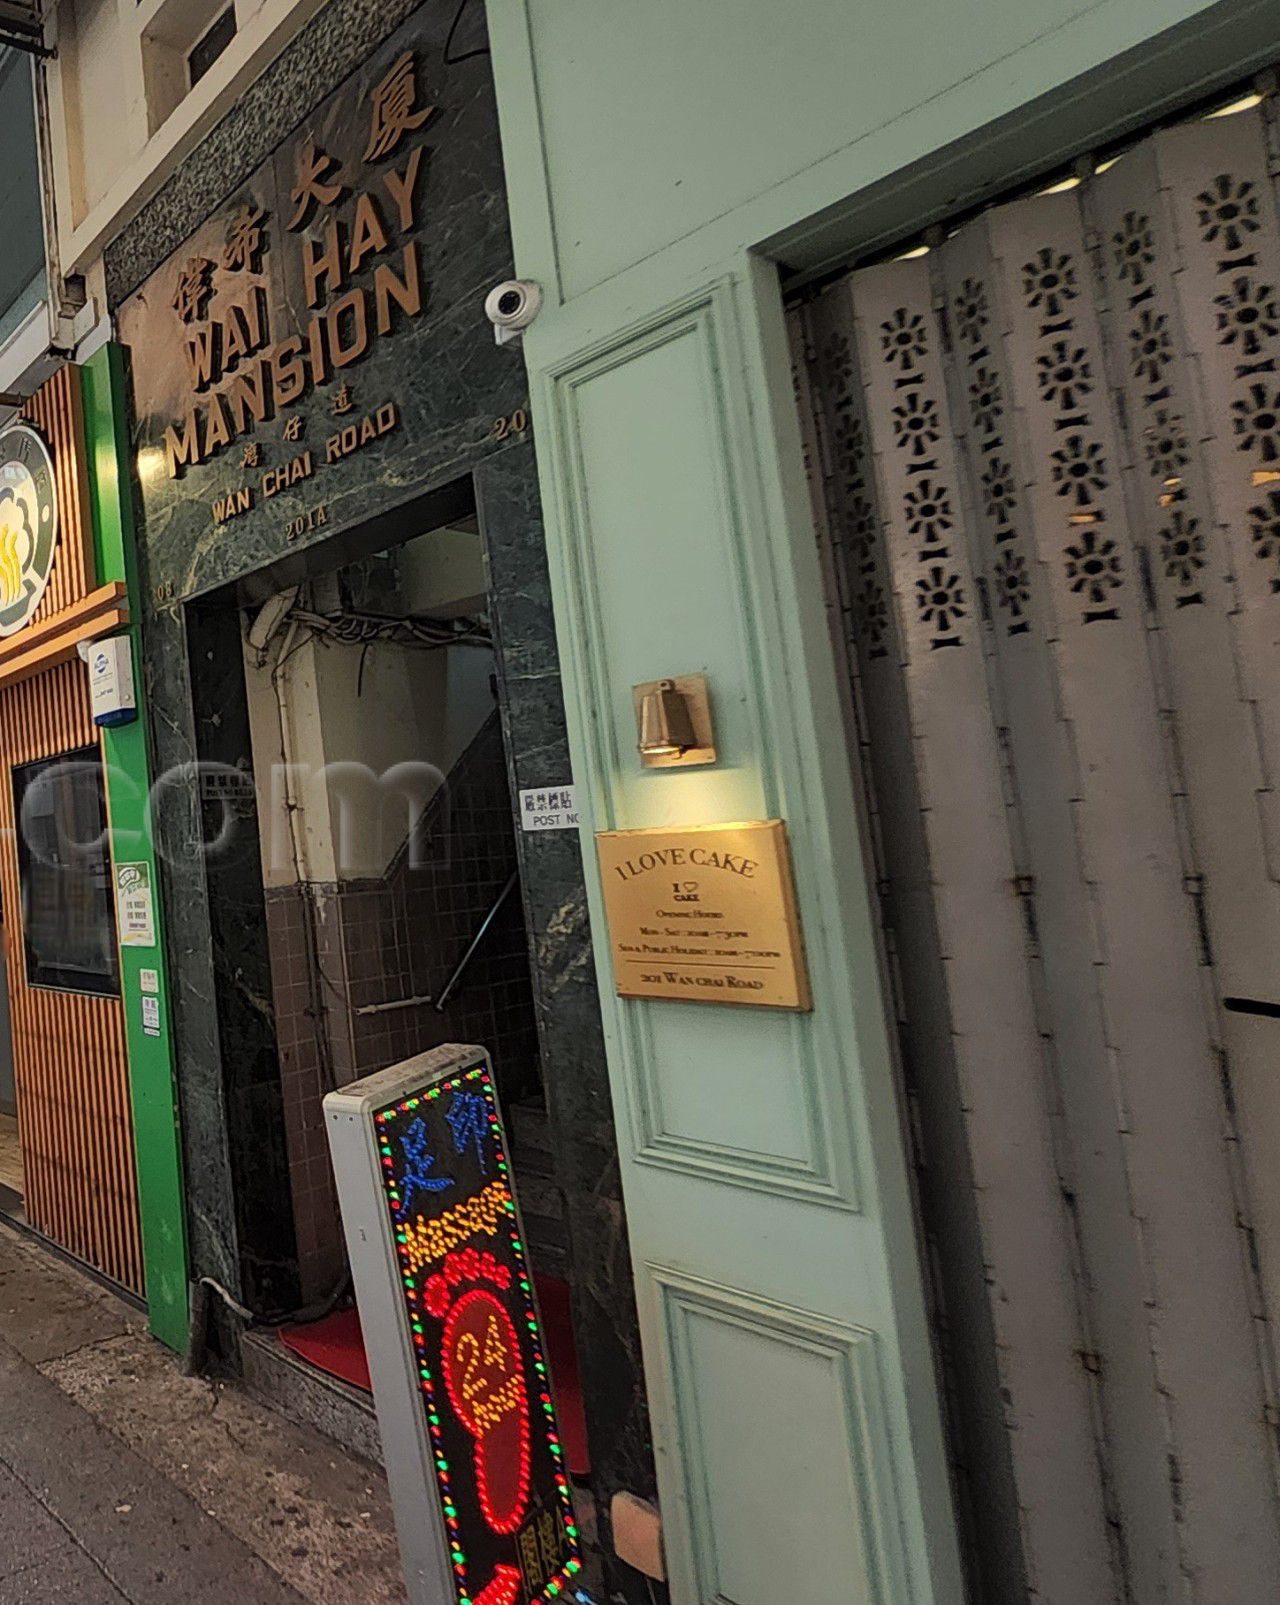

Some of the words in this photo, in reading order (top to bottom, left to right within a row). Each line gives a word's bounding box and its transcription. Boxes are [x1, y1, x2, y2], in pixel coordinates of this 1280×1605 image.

[183, 286, 263, 392] WAI
[303, 145, 424, 309] HAY
[165, 241, 422, 479] MANSION
[212, 486, 251, 526] WAN
[261, 451, 311, 498] CHAI
[325, 402, 397, 464] ROAD
[240, 381, 352, 469] 灣仔道
[286, 504, 328, 541] 201A
[533, 814, 560, 826] POST
[614, 865, 628, 881] I
[624, 848, 687, 876] LOVE
[689, 848, 760, 878] CAKE
[456, 1314, 508, 1400] 24
